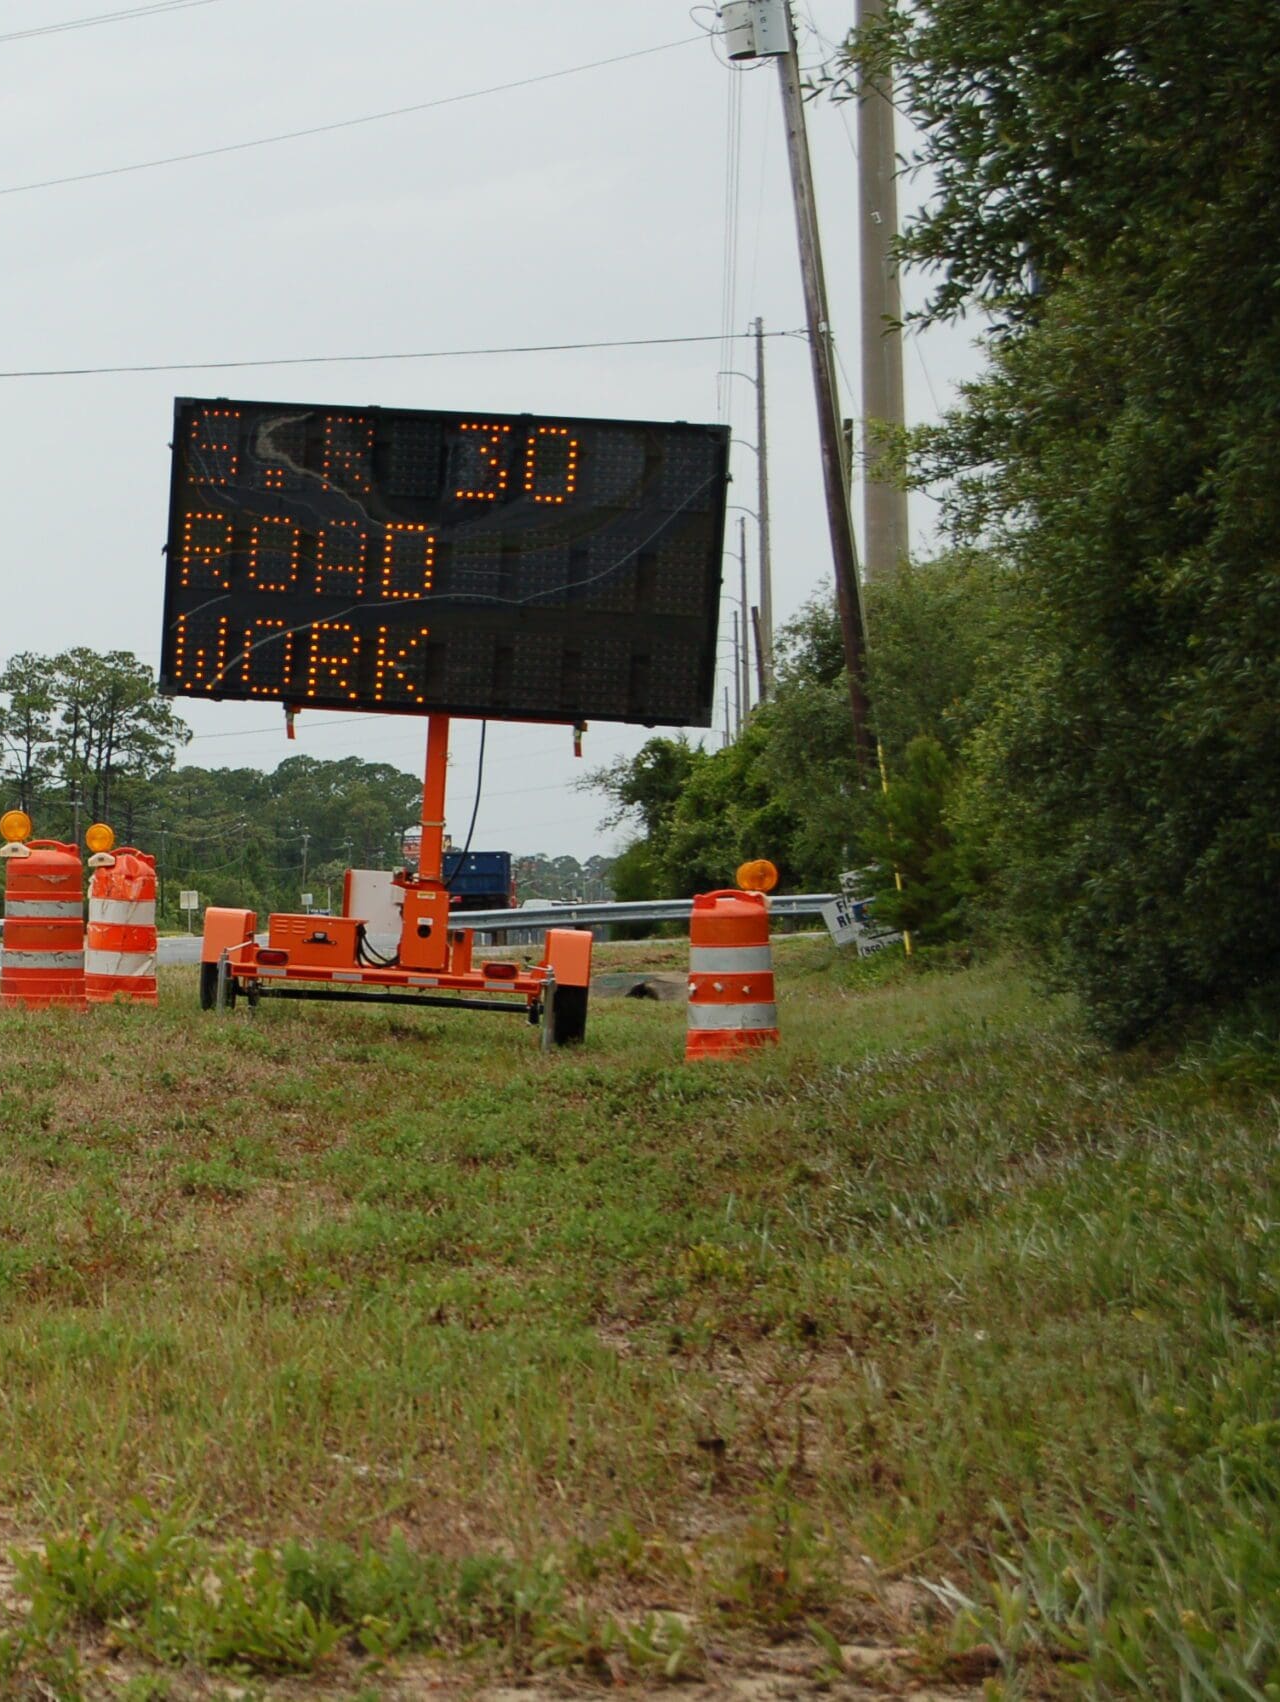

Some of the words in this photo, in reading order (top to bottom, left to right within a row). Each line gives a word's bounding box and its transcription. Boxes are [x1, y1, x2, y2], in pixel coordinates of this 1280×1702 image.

[456, 422, 579, 503] 30
[180, 511, 435, 600] ROAD
[174, 612, 431, 703] WORK
